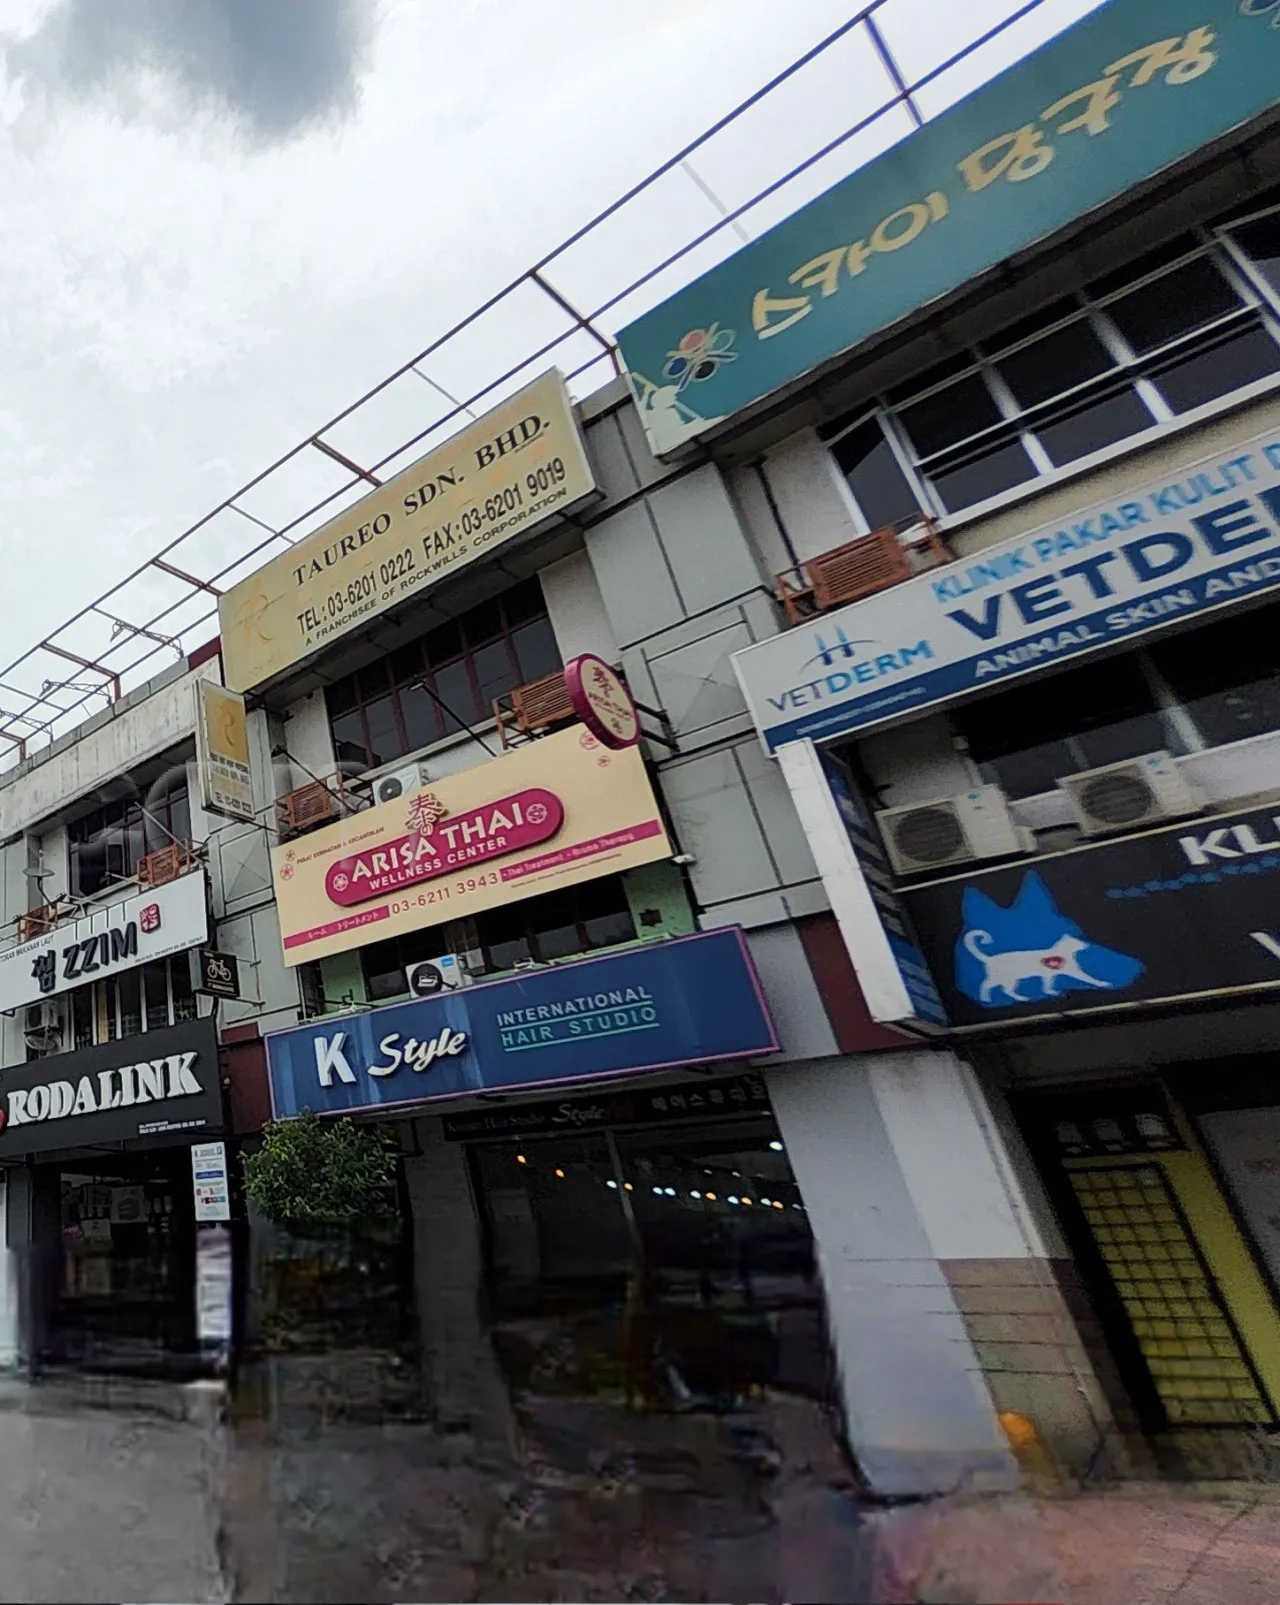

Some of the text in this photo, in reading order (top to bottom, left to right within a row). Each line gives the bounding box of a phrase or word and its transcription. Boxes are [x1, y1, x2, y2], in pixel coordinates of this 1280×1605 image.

[292, 415, 551, 587] TAUREO SDN. BHD.
[380, 548, 416, 586] 0222
[526, 457, 566, 497] 9019
[931, 547, 1035, 602] KLINIK
[1032, 501, 1152, 562] PAKAR
[1148, 454, 1257, 515] KULIT
[305, 486, 568, 647] A FRANCHISEE OF ROCKWILLS CORPORATION
[974, 624, 1105, 677] ANIMAL
[1105, 589, 1197, 631] SKIN
[765, 639, 936, 711] VETDERM
[352, 802, 524, 883] ARISA THAI
[369, 836, 508, 890] WELLNESS CENTER
[391, 872, 499, 915] 03-6211 3943
[62, 921, 138, 980] ZZIM
[496, 985, 653, 1028] INTERNATIONAL
[500, 1006, 657, 1047] HAIR STUDIO
[7, 1051, 204, 1127] RODALINK
[313, 1028, 467, 1087] K Style
